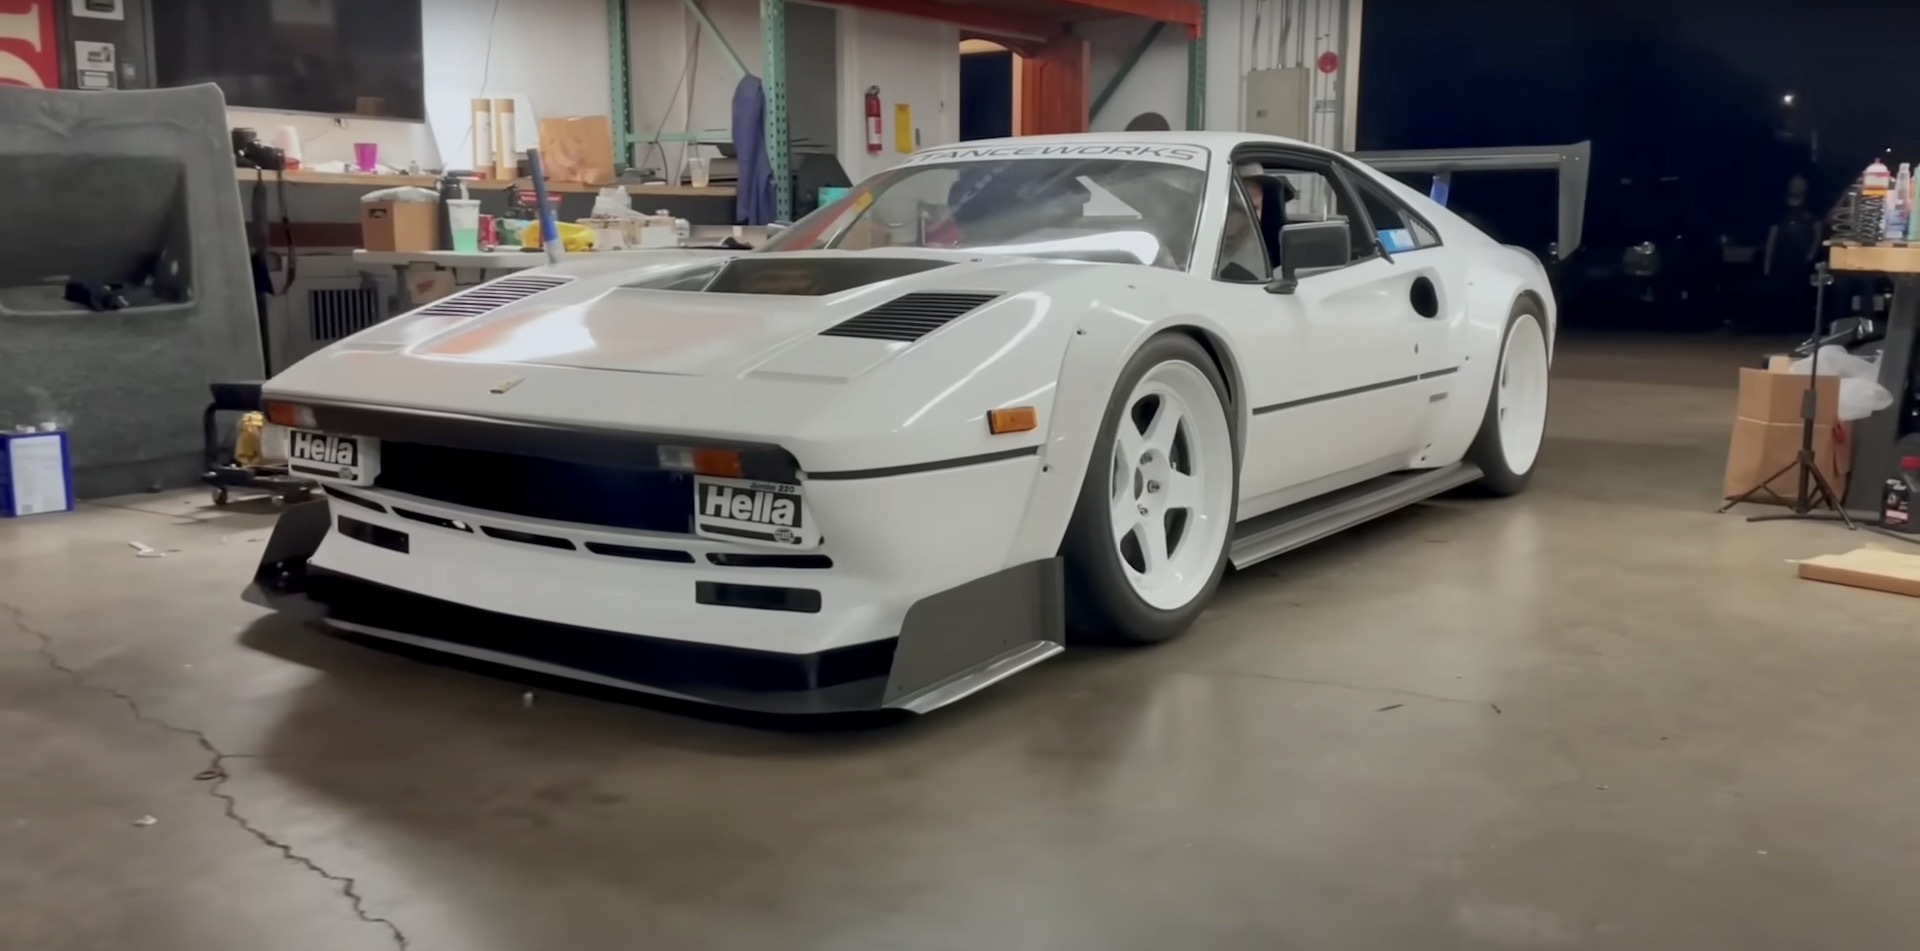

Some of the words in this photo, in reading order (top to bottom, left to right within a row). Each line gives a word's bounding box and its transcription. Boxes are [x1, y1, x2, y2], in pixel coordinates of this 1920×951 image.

[294, 432, 353, 465] Hella
[705, 485, 795, 526] Hella
[778, 485, 795, 493] 220
